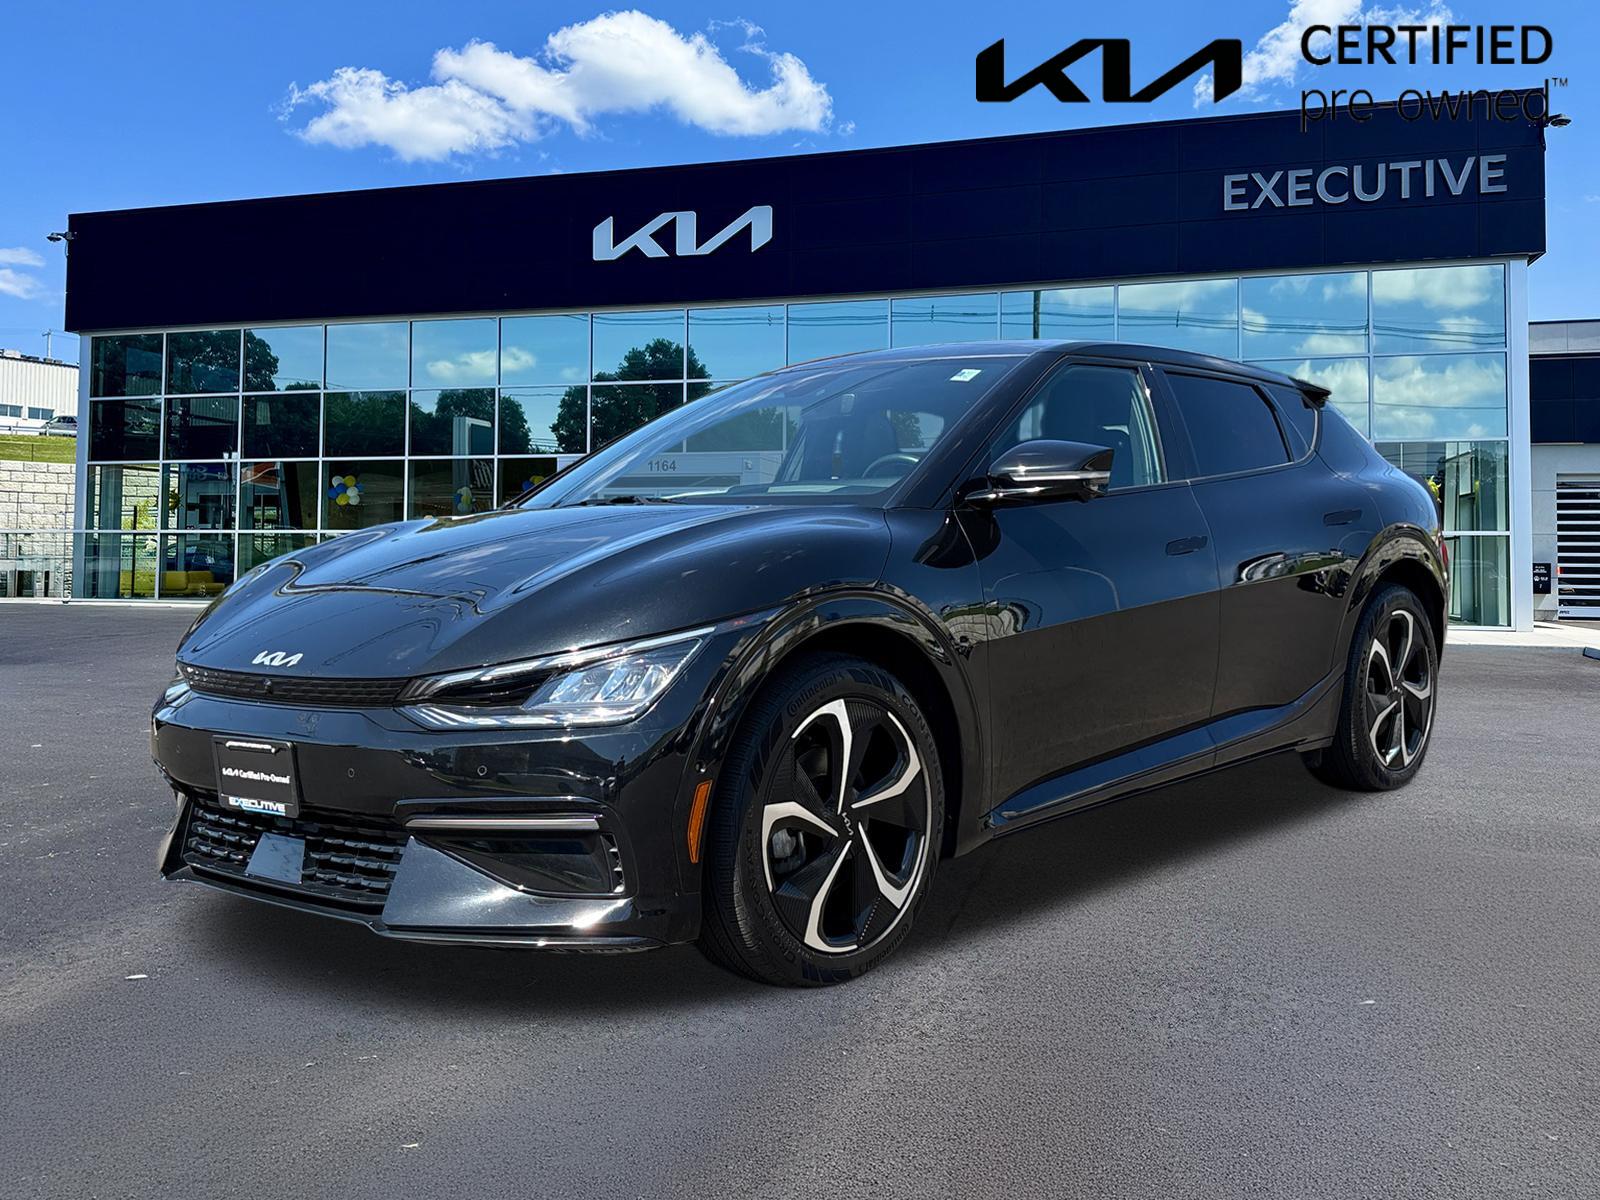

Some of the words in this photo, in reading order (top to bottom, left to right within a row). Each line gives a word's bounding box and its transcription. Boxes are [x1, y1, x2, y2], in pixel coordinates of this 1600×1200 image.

[1223, 154, 1508, 211] EXECUTIVE
[592, 205, 773, 261] KIA
[647, 460, 677, 472] 1164
[251, 650, 304, 667] KIA
[228, 796, 286, 812] EXECUTIVE
